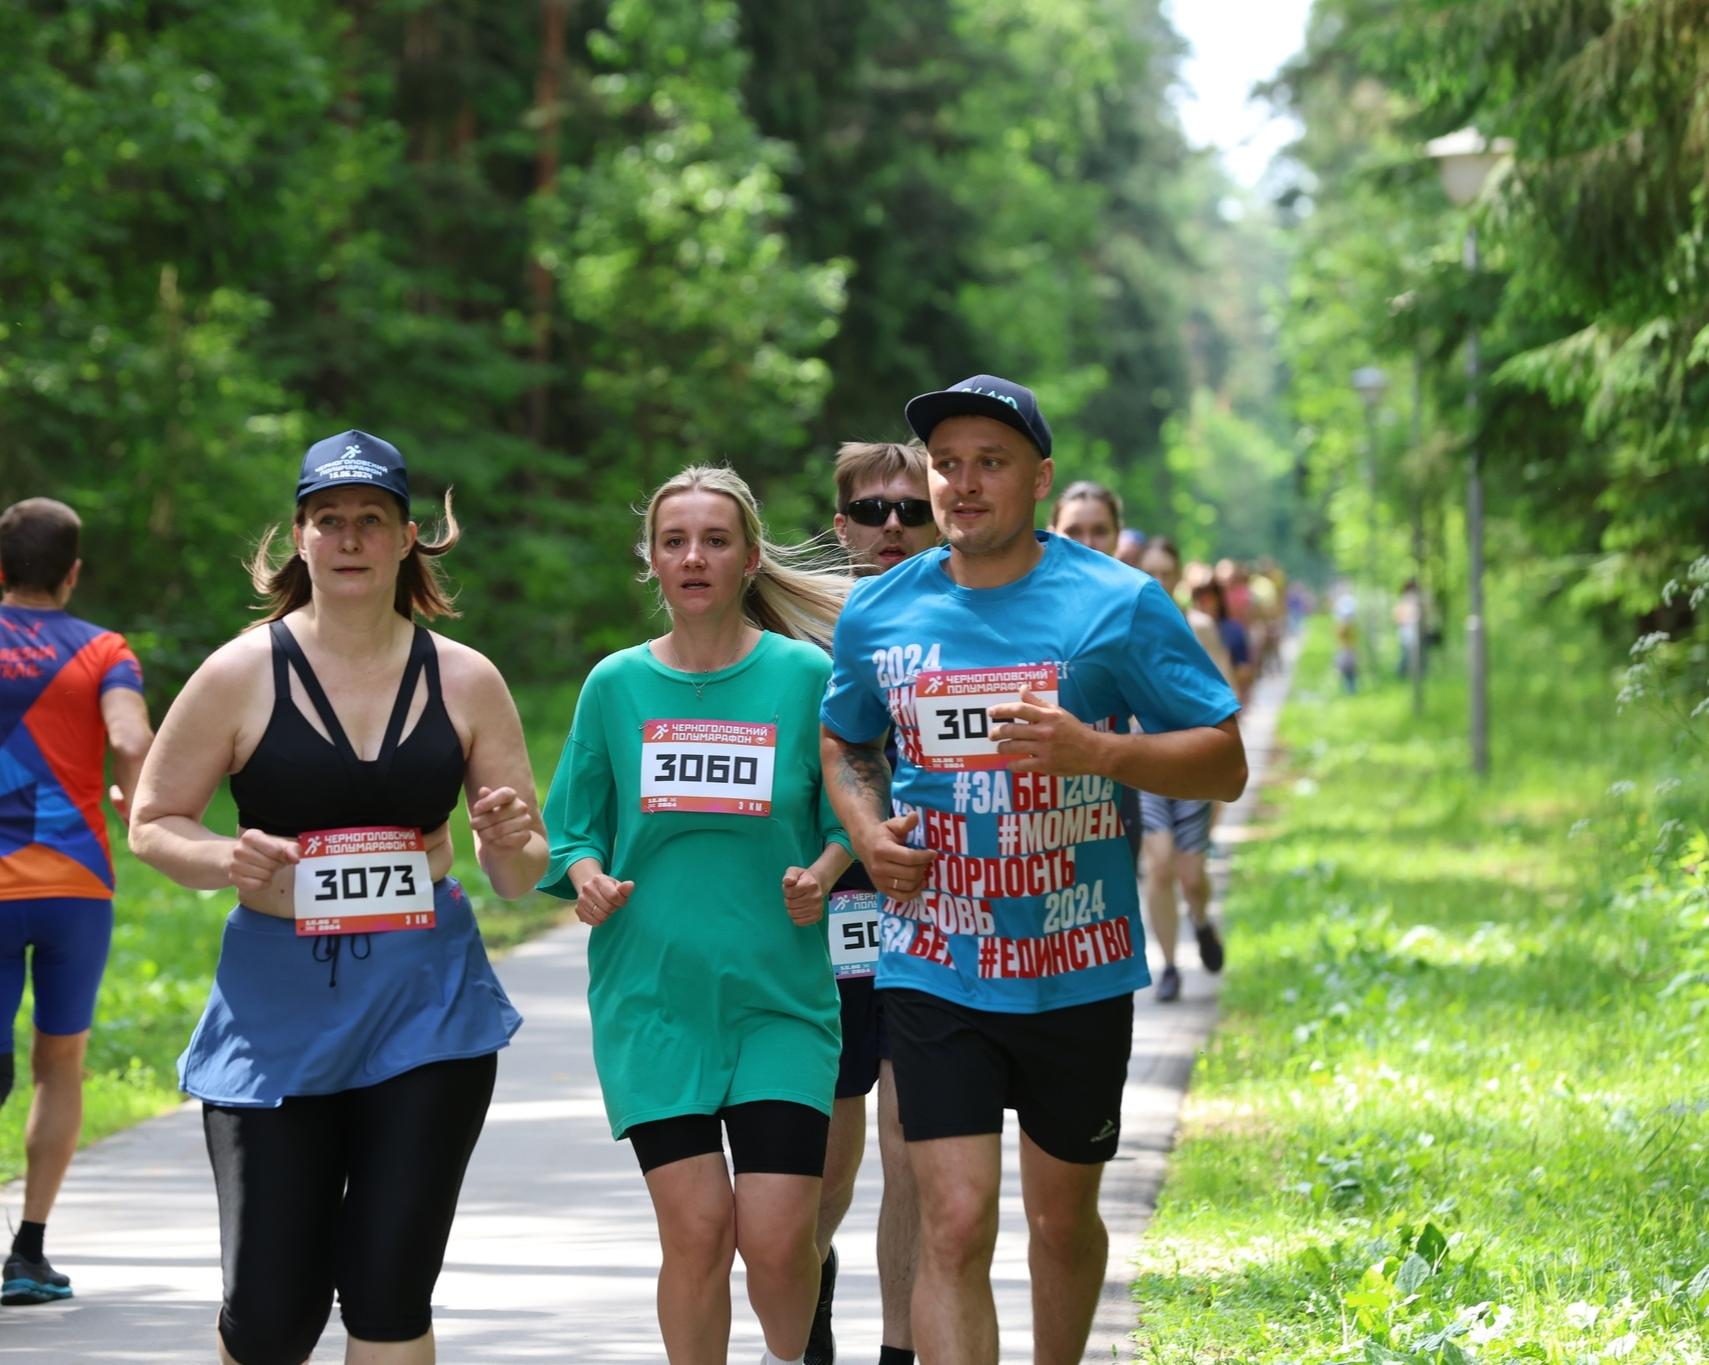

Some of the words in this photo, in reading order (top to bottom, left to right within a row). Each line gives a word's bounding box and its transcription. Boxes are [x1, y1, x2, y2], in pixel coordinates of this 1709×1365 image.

[872, 643, 942, 688] 2024
[946, 669, 1049, 684] ЧЕРНОГОЛОВСКИЙ
[671, 733, 752, 744] ПОЛУМАРАФОН
[672, 724, 768, 737] ЧЕРНОГОЛОВСКИЙ
[936, 707, 1014, 740] 30
[654, 754, 758, 785] 3060
[324, 830, 416, 844] ЧЕРНОГОЛОВСКИЙ
[998, 800, 1125, 857] #МОМЕН
[325, 841, 406, 854] ПОЛУМАРАФОН
[315, 865, 416, 901] 3073
[1043, 880, 1105, 934] 2024
[978, 916, 1134, 979] #ЕДИНСТВО
